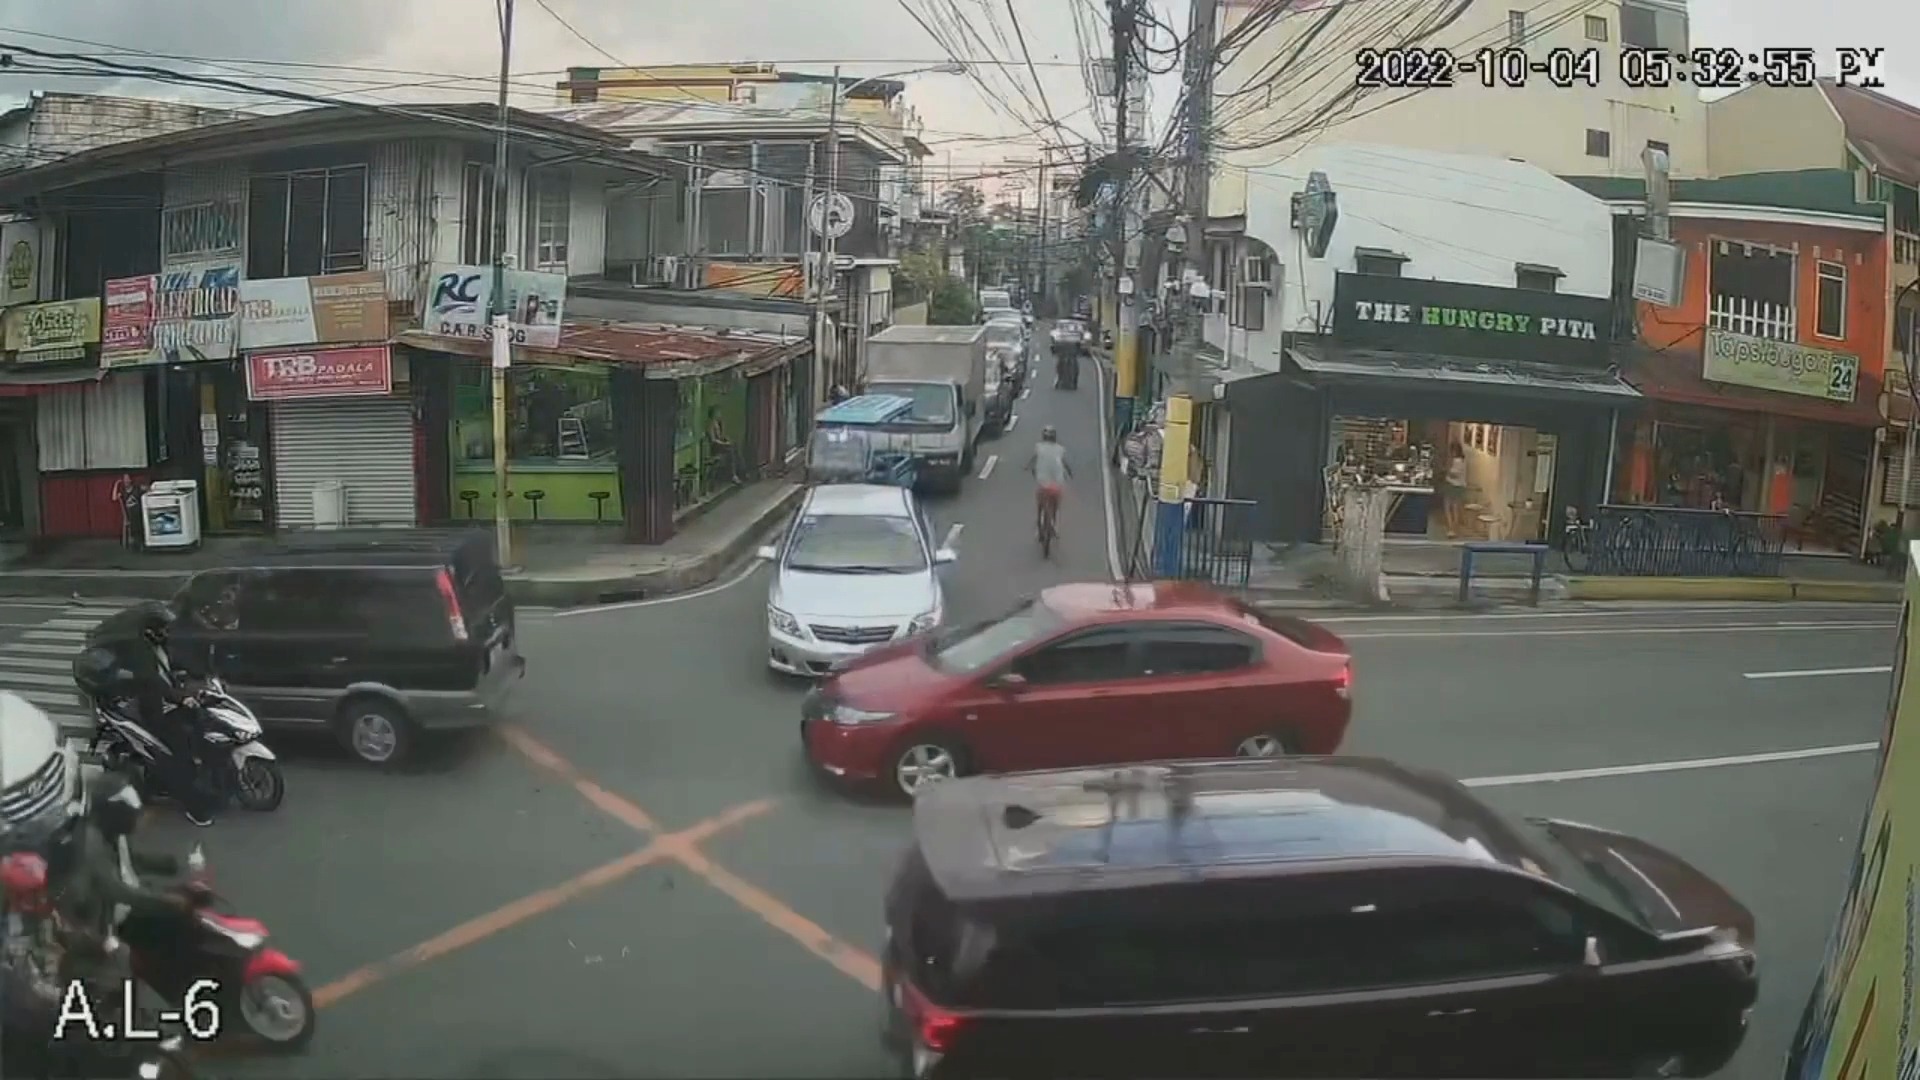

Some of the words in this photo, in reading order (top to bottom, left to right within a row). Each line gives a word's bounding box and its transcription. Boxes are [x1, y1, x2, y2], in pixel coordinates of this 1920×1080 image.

[432, 273, 481, 308] RC
[1356, 301, 1411, 323] THE
[1421, 306, 1532, 333] HUNGRY
[1540, 317, 1597, 341] PITA
[263, 355, 317, 379] TRB
[317, 362, 375, 374] PADALA
[1832, 366, 1852, 390] 24
